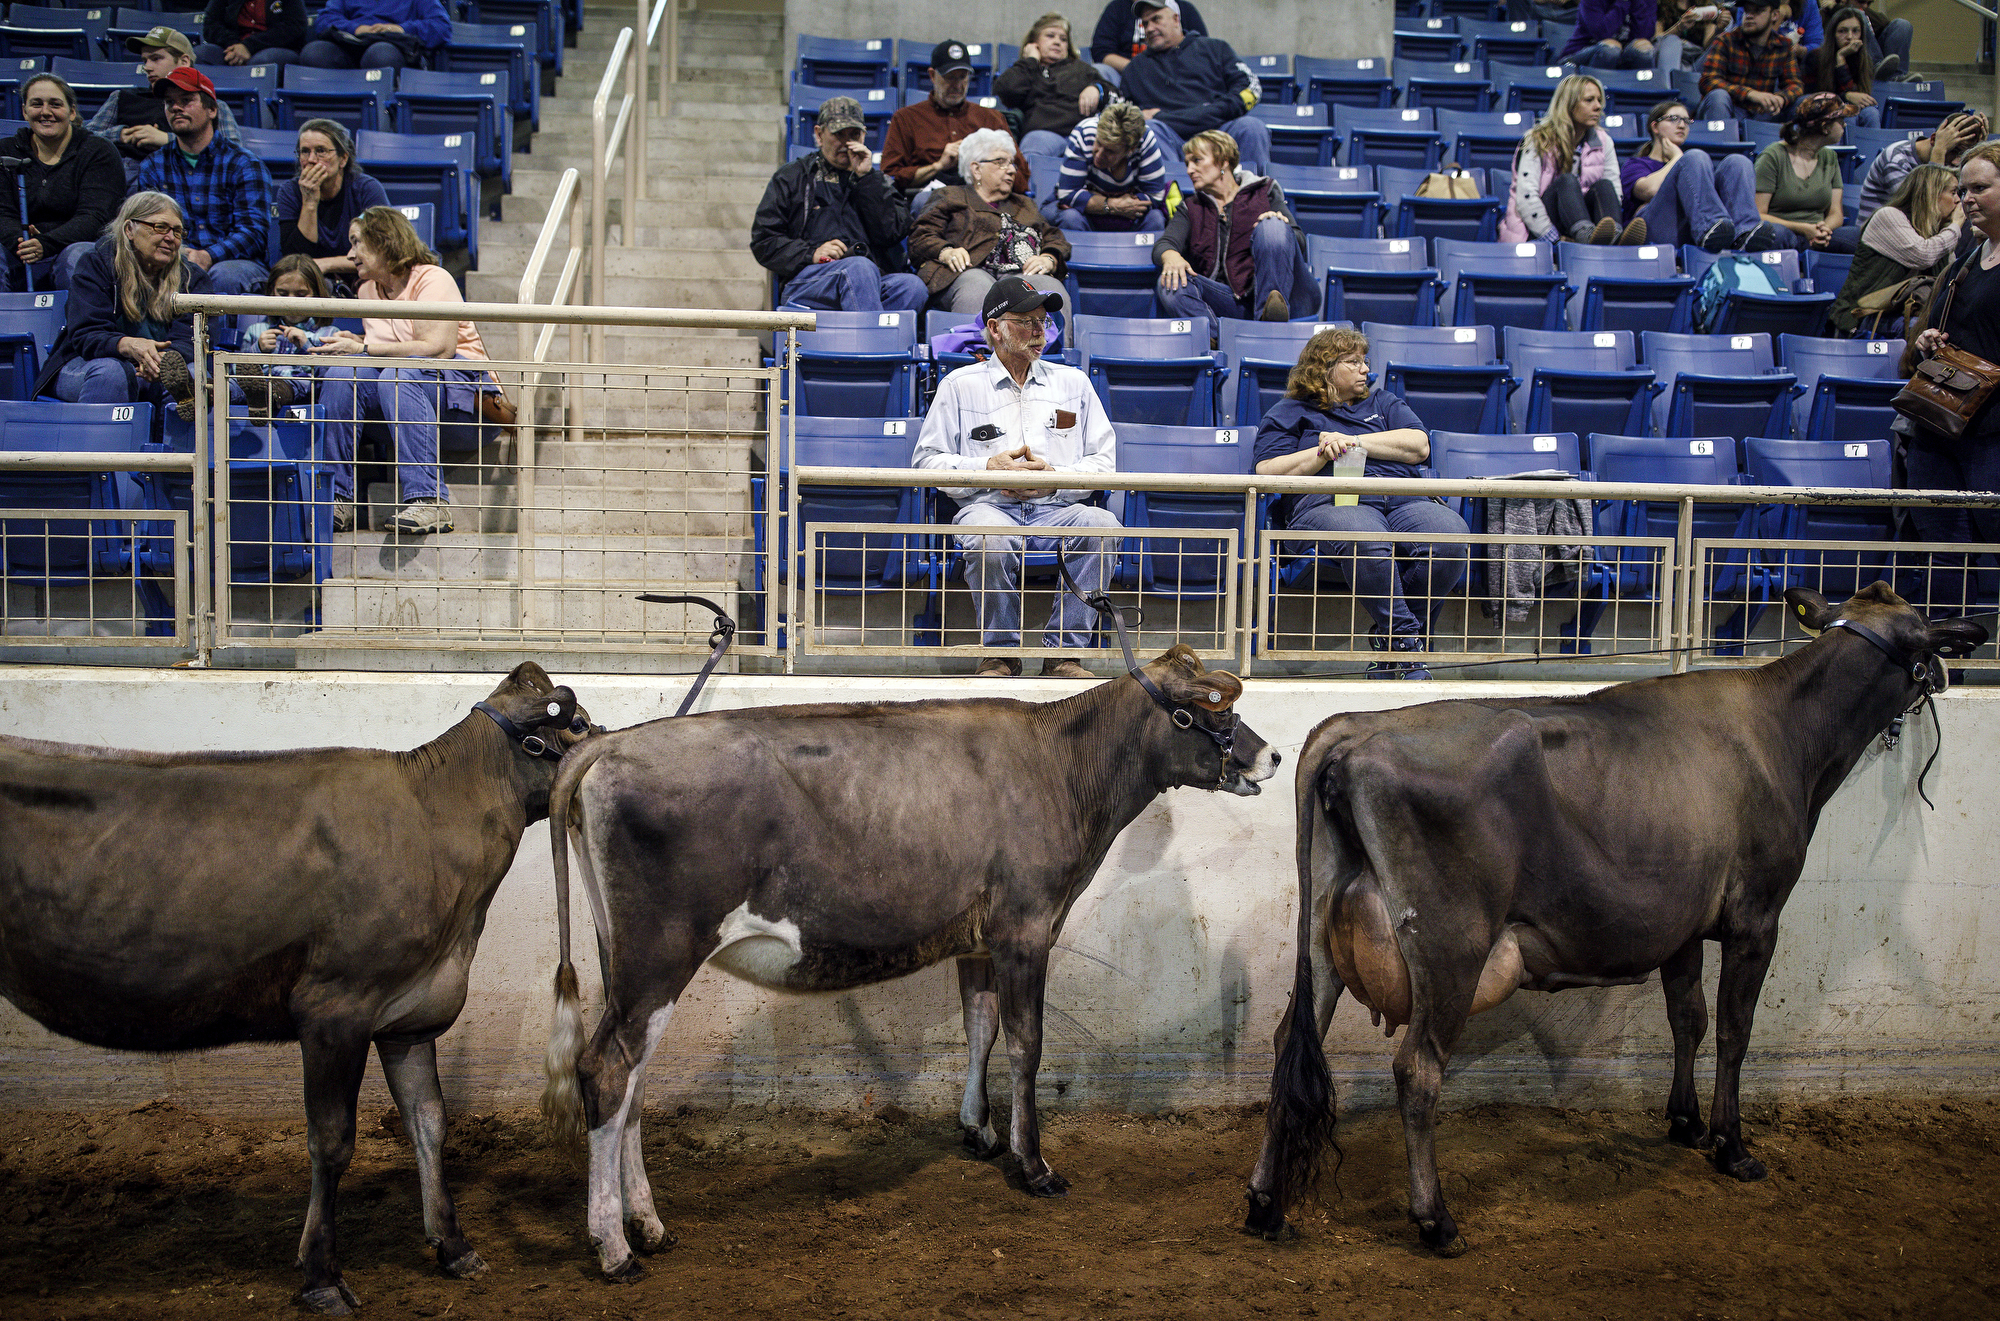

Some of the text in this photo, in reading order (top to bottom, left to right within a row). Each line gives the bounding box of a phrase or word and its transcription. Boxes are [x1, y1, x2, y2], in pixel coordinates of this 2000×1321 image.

[41, 295, 48, 307] 9
[886, 315, 891, 325] 1
[1177, 321, 1184, 332] 3
[1462, 330, 1469, 342] 5
[1601, 336, 1608, 347] 6
[1738, 338, 1745, 348] 7
[1874, 343, 1881, 354] 8
[116, 408, 130, 420] 10
[891, 422, 898, 434] 1
[1223, 430, 1231, 443] 3
[1541, 438, 1549, 450] 5
[1698, 442, 1705, 454] 6
[1852, 445, 1859, 457] 7
